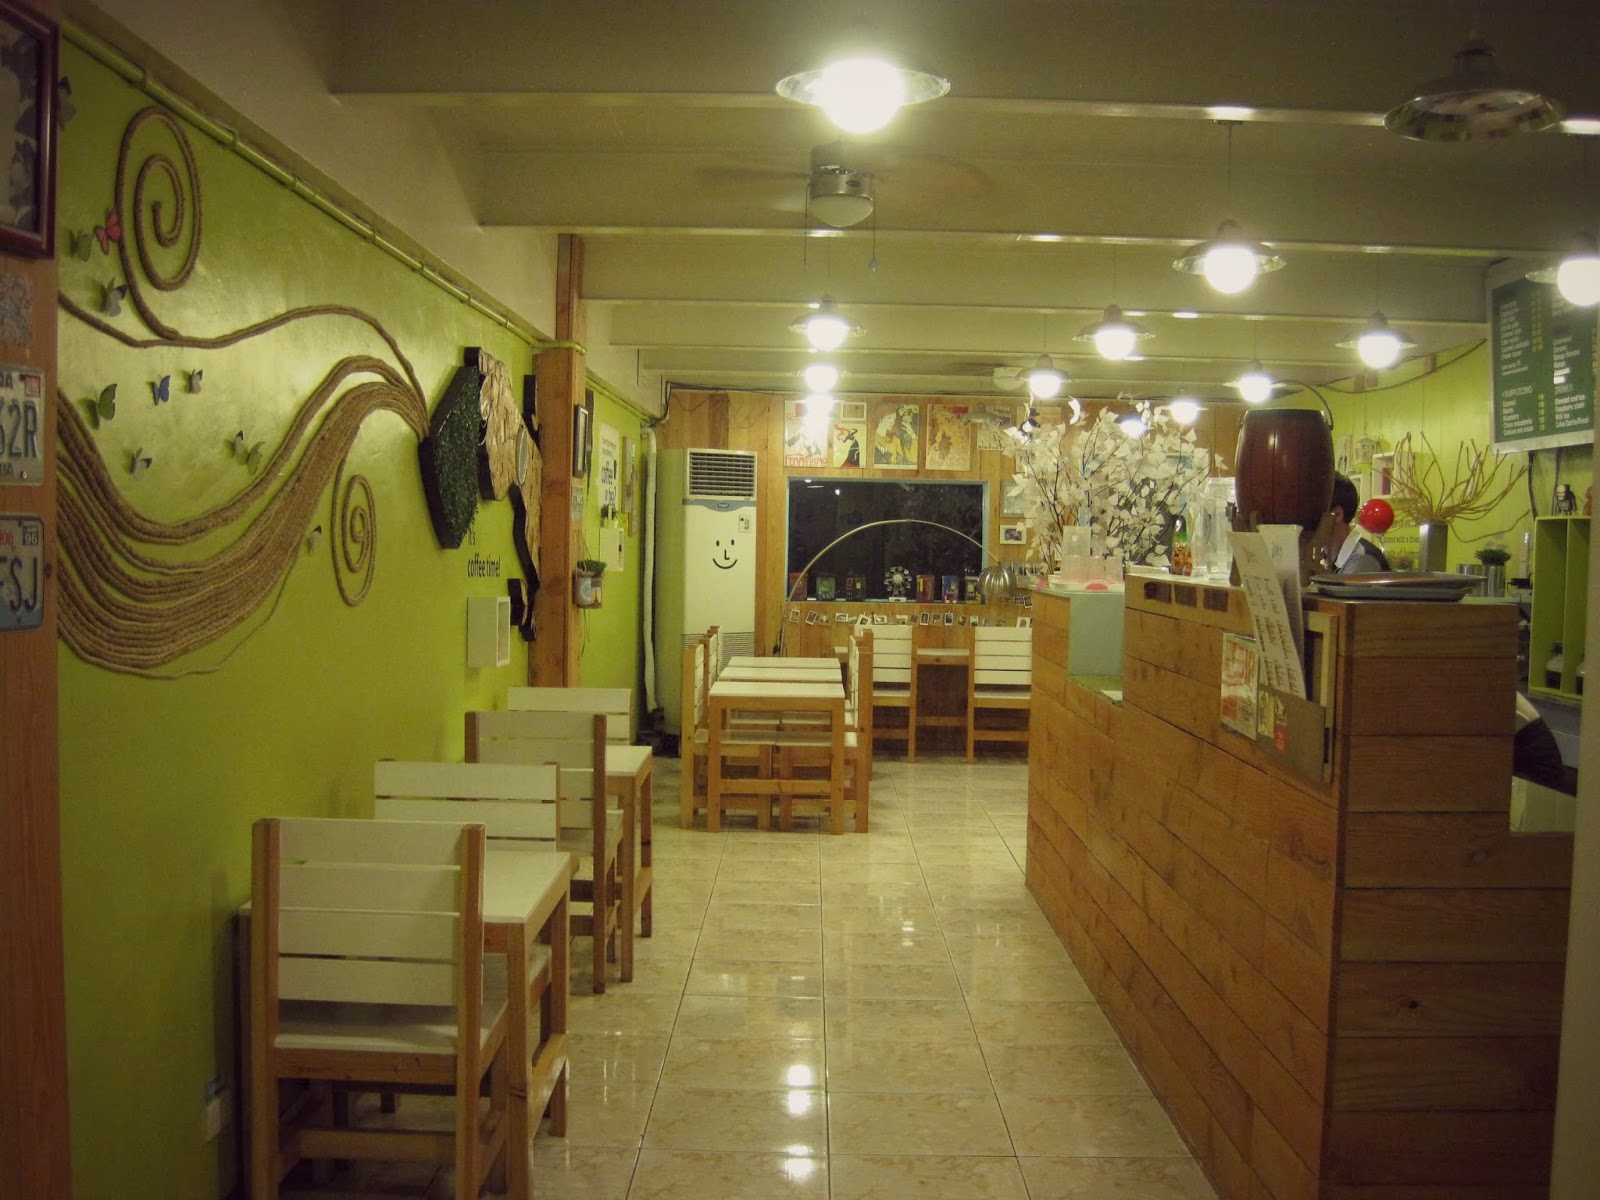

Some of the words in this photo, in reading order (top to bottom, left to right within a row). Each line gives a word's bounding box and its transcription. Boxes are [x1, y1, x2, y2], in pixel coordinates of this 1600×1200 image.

[25, 533, 38, 545] 96
[468, 553, 486, 577] coffee
[486, 554, 501, 577] time!
